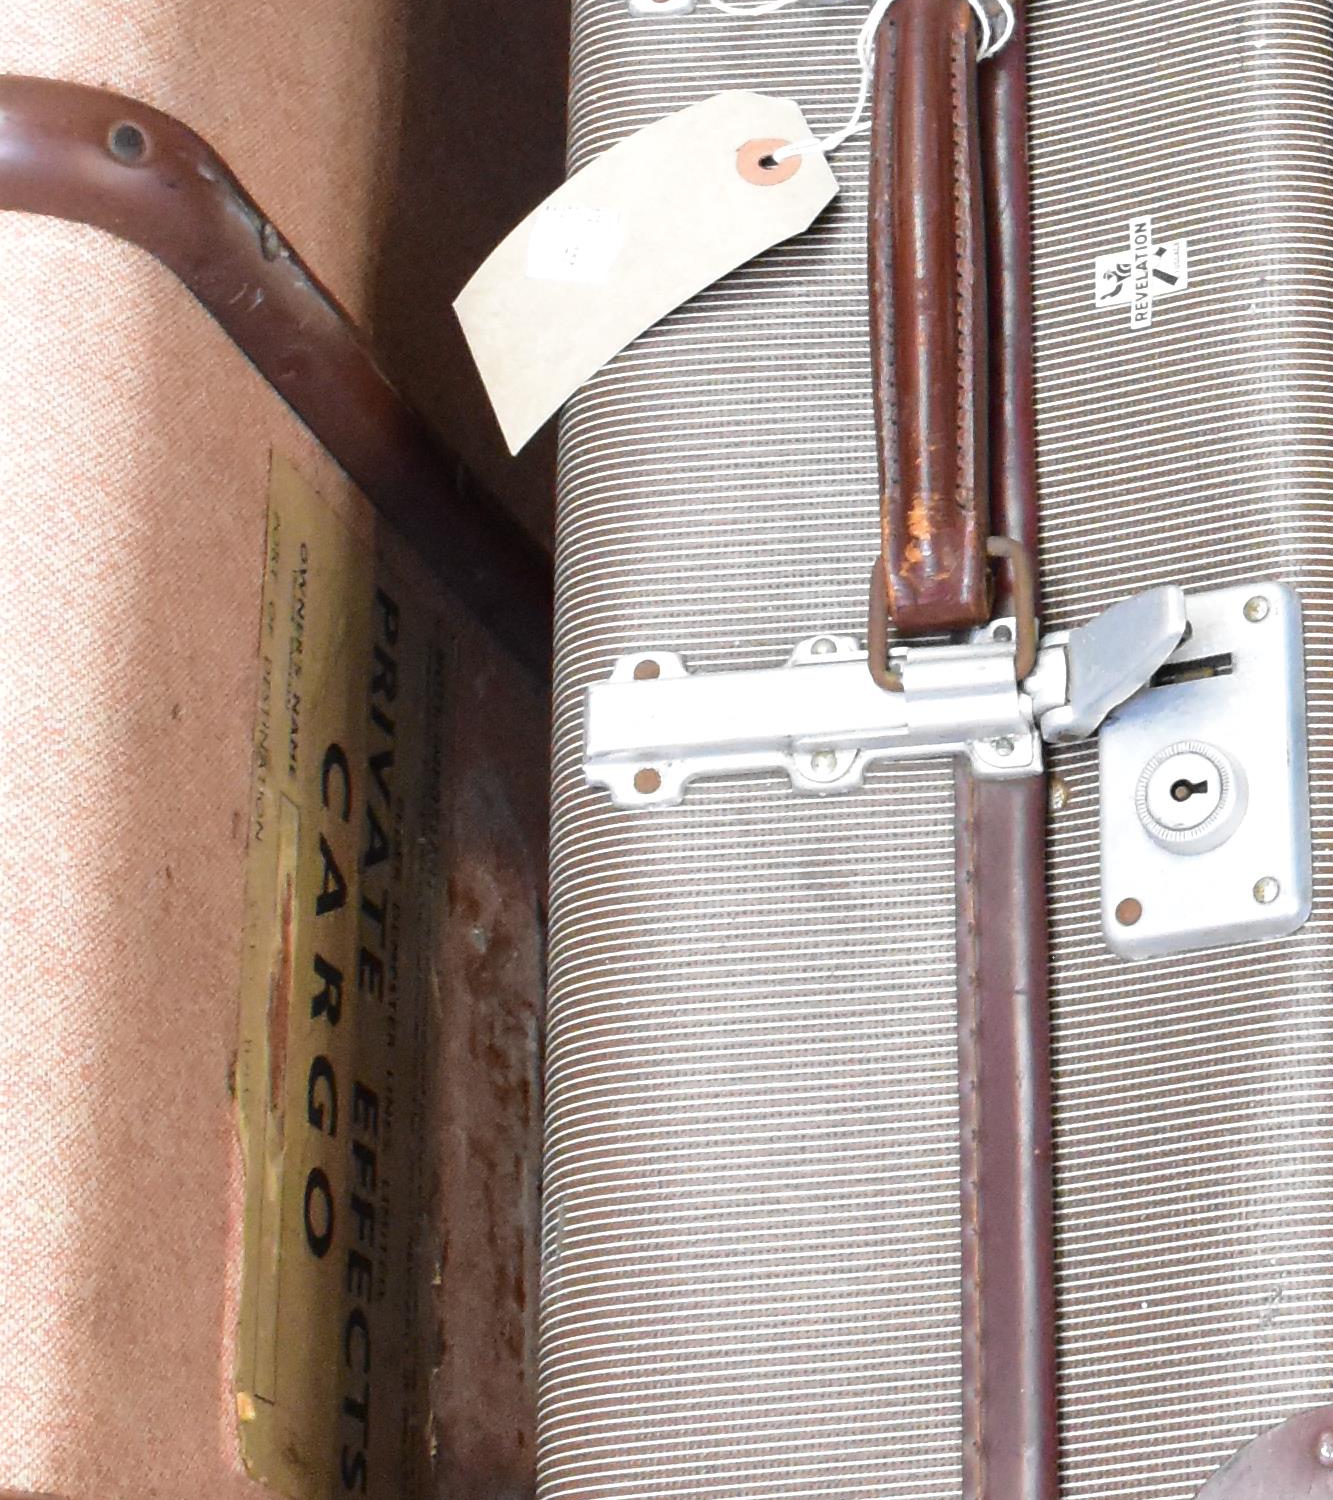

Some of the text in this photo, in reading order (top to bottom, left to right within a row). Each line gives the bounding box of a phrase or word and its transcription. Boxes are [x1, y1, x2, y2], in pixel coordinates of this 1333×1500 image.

[1134, 222, 1149, 322] REVELATION
[254, 655, 273, 844] DESTINATION
[287, 692, 302, 780] NAME
[304, 742, 354, 1261] CARGO
[340, 585, 400, 1497] PRIVATE EFFECTS
